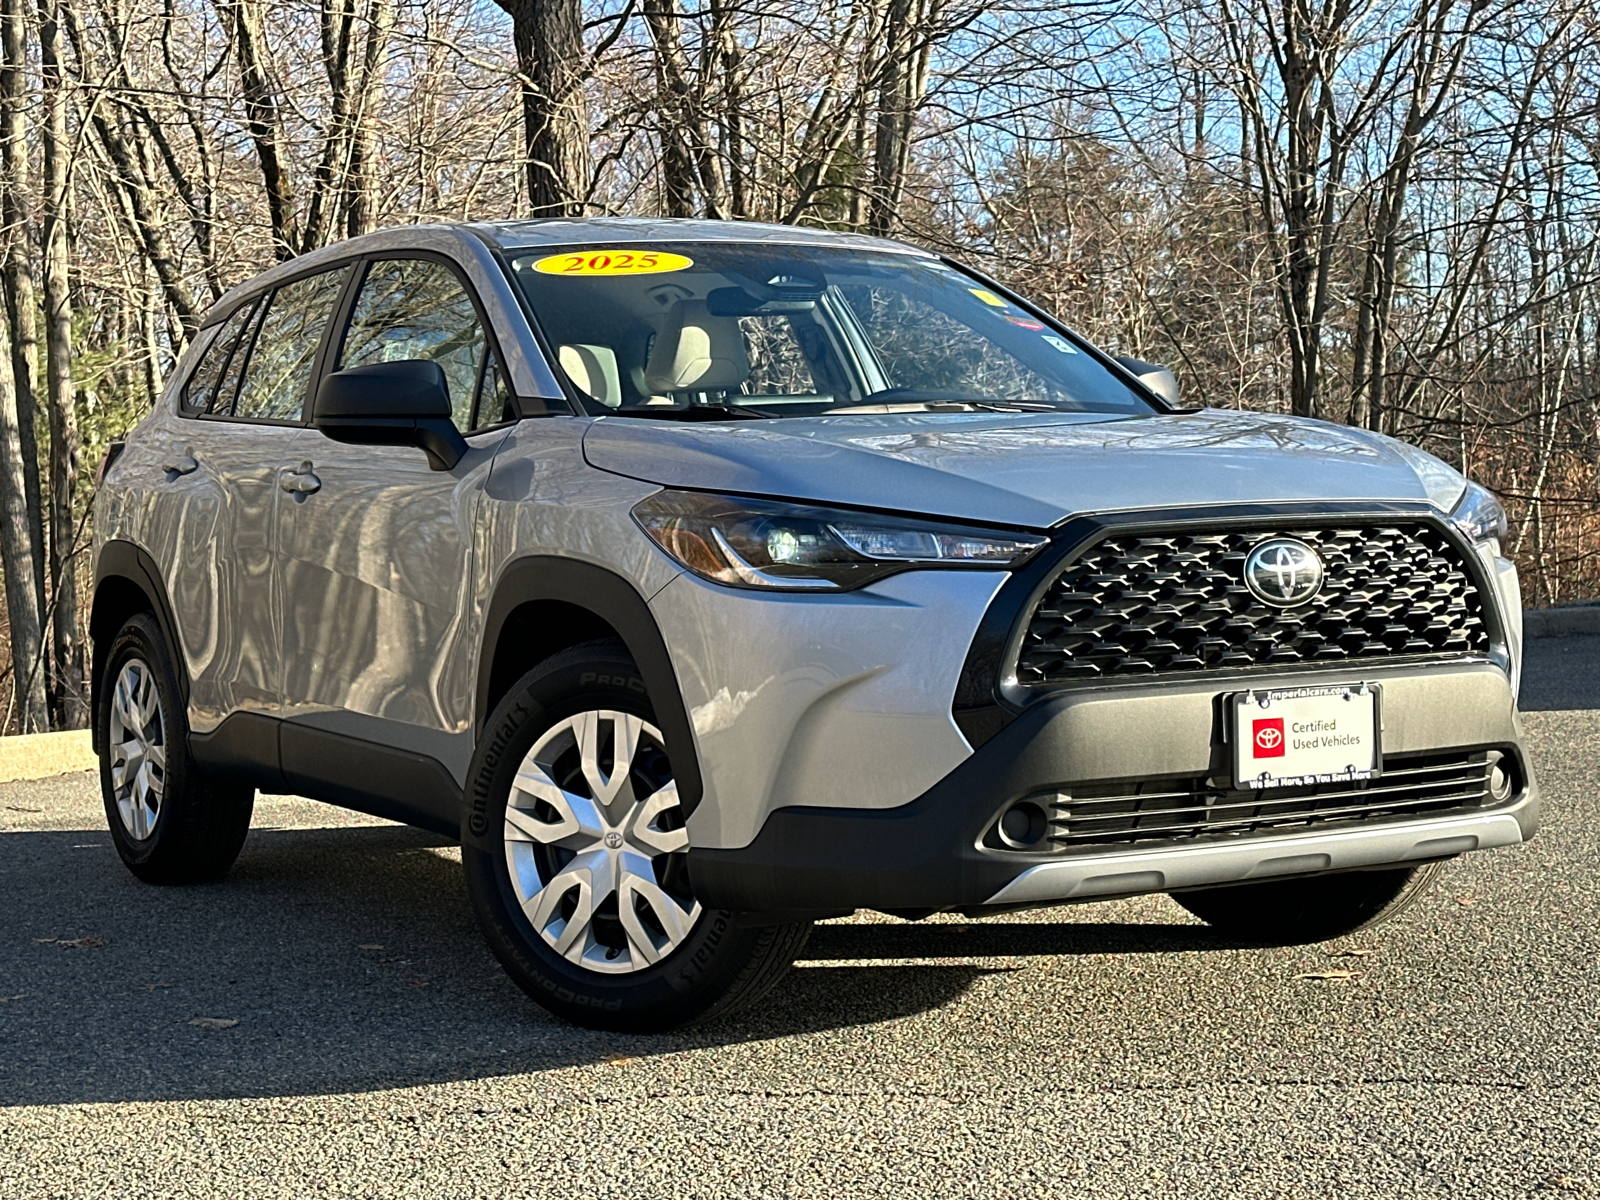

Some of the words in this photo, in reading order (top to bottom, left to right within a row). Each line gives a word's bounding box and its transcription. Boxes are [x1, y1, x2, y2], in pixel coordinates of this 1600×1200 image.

[563, 253, 660, 272] 2025
[1291, 718, 1337, 734] Certified
[1292, 736, 1319, 750] Used
[1321, 734, 1361, 748] Vehicles
[468, 712, 521, 838] Continental
[1249, 780, 1263, 789] We
[1264, 778, 1279, 789] Sell
[1304, 775, 1314, 785] So
[1316, 773, 1332, 784] You
[1332, 772, 1351, 782] Save
[1352, 770, 1372, 781] More
